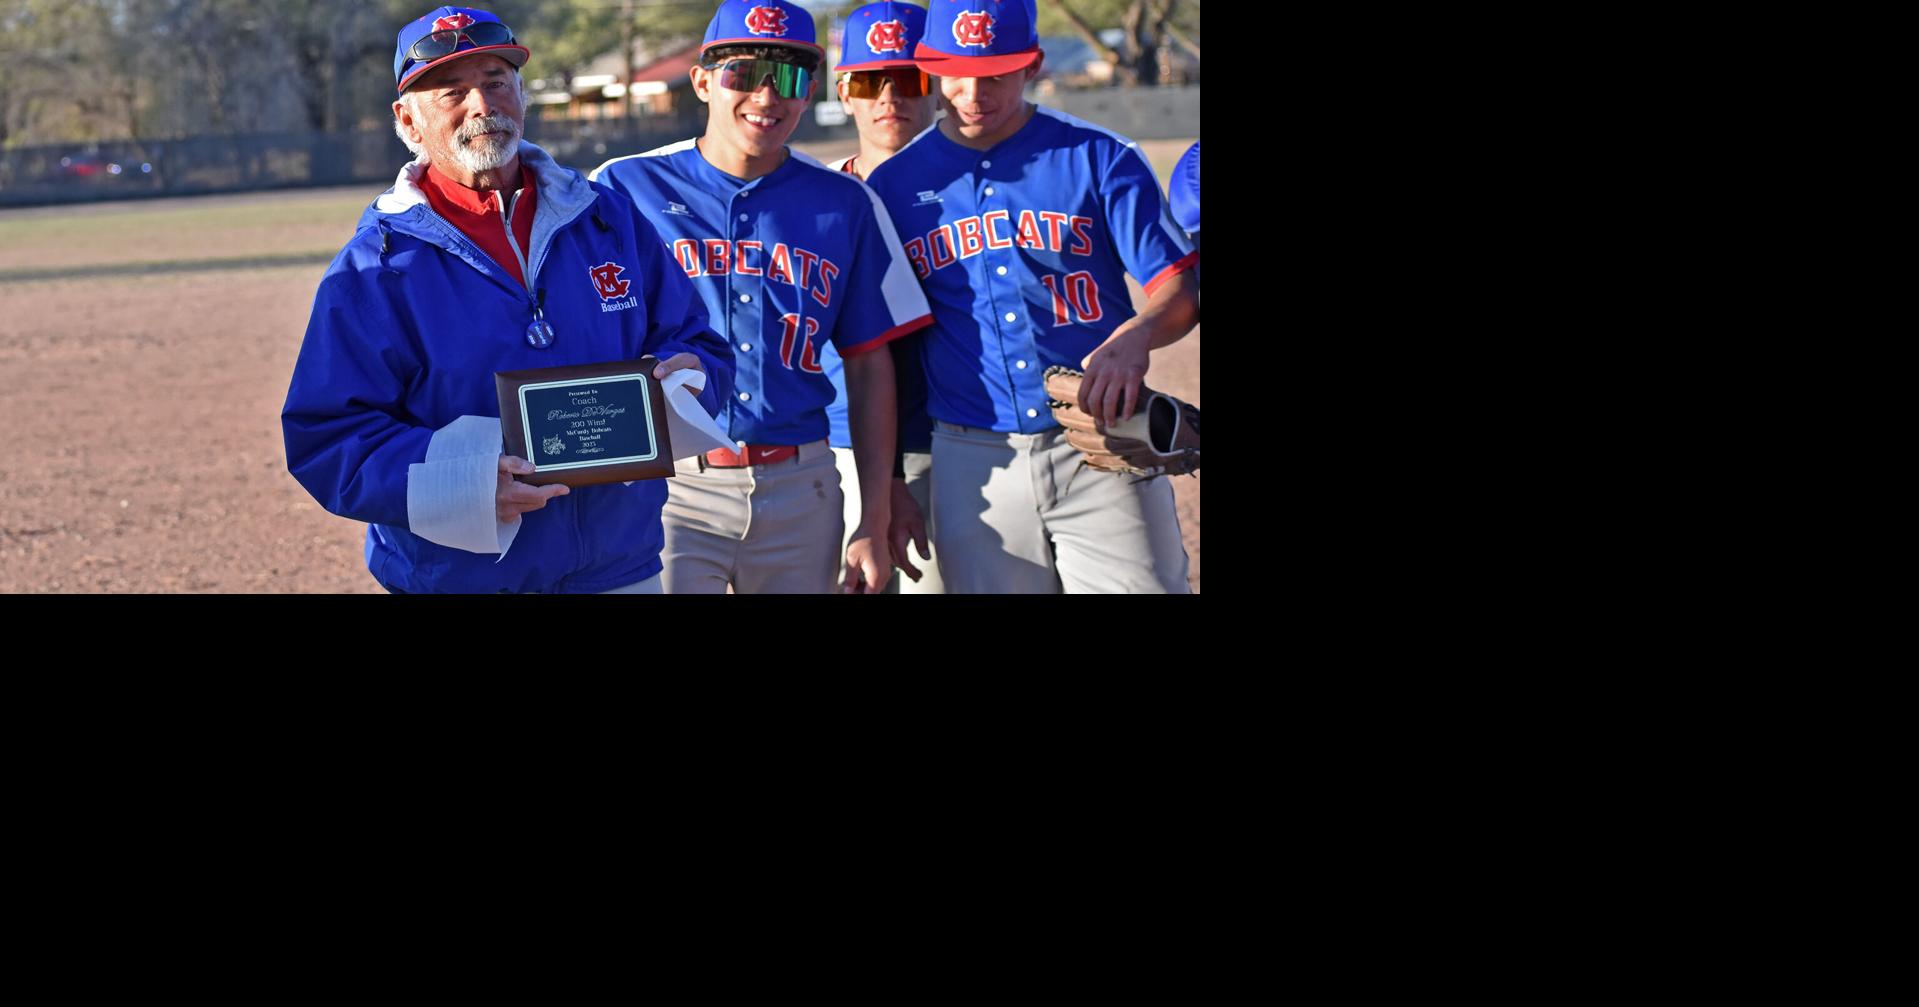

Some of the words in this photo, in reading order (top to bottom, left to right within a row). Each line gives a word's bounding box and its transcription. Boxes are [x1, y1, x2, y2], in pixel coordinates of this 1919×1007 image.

[665, 238, 840, 308] OBCATS
[904, 210, 1093, 280] BOBCATS
[601, 297, 637, 312] Baseball
[1042, 270, 1103, 328] 10
[571, 396, 597, 406] Coach
